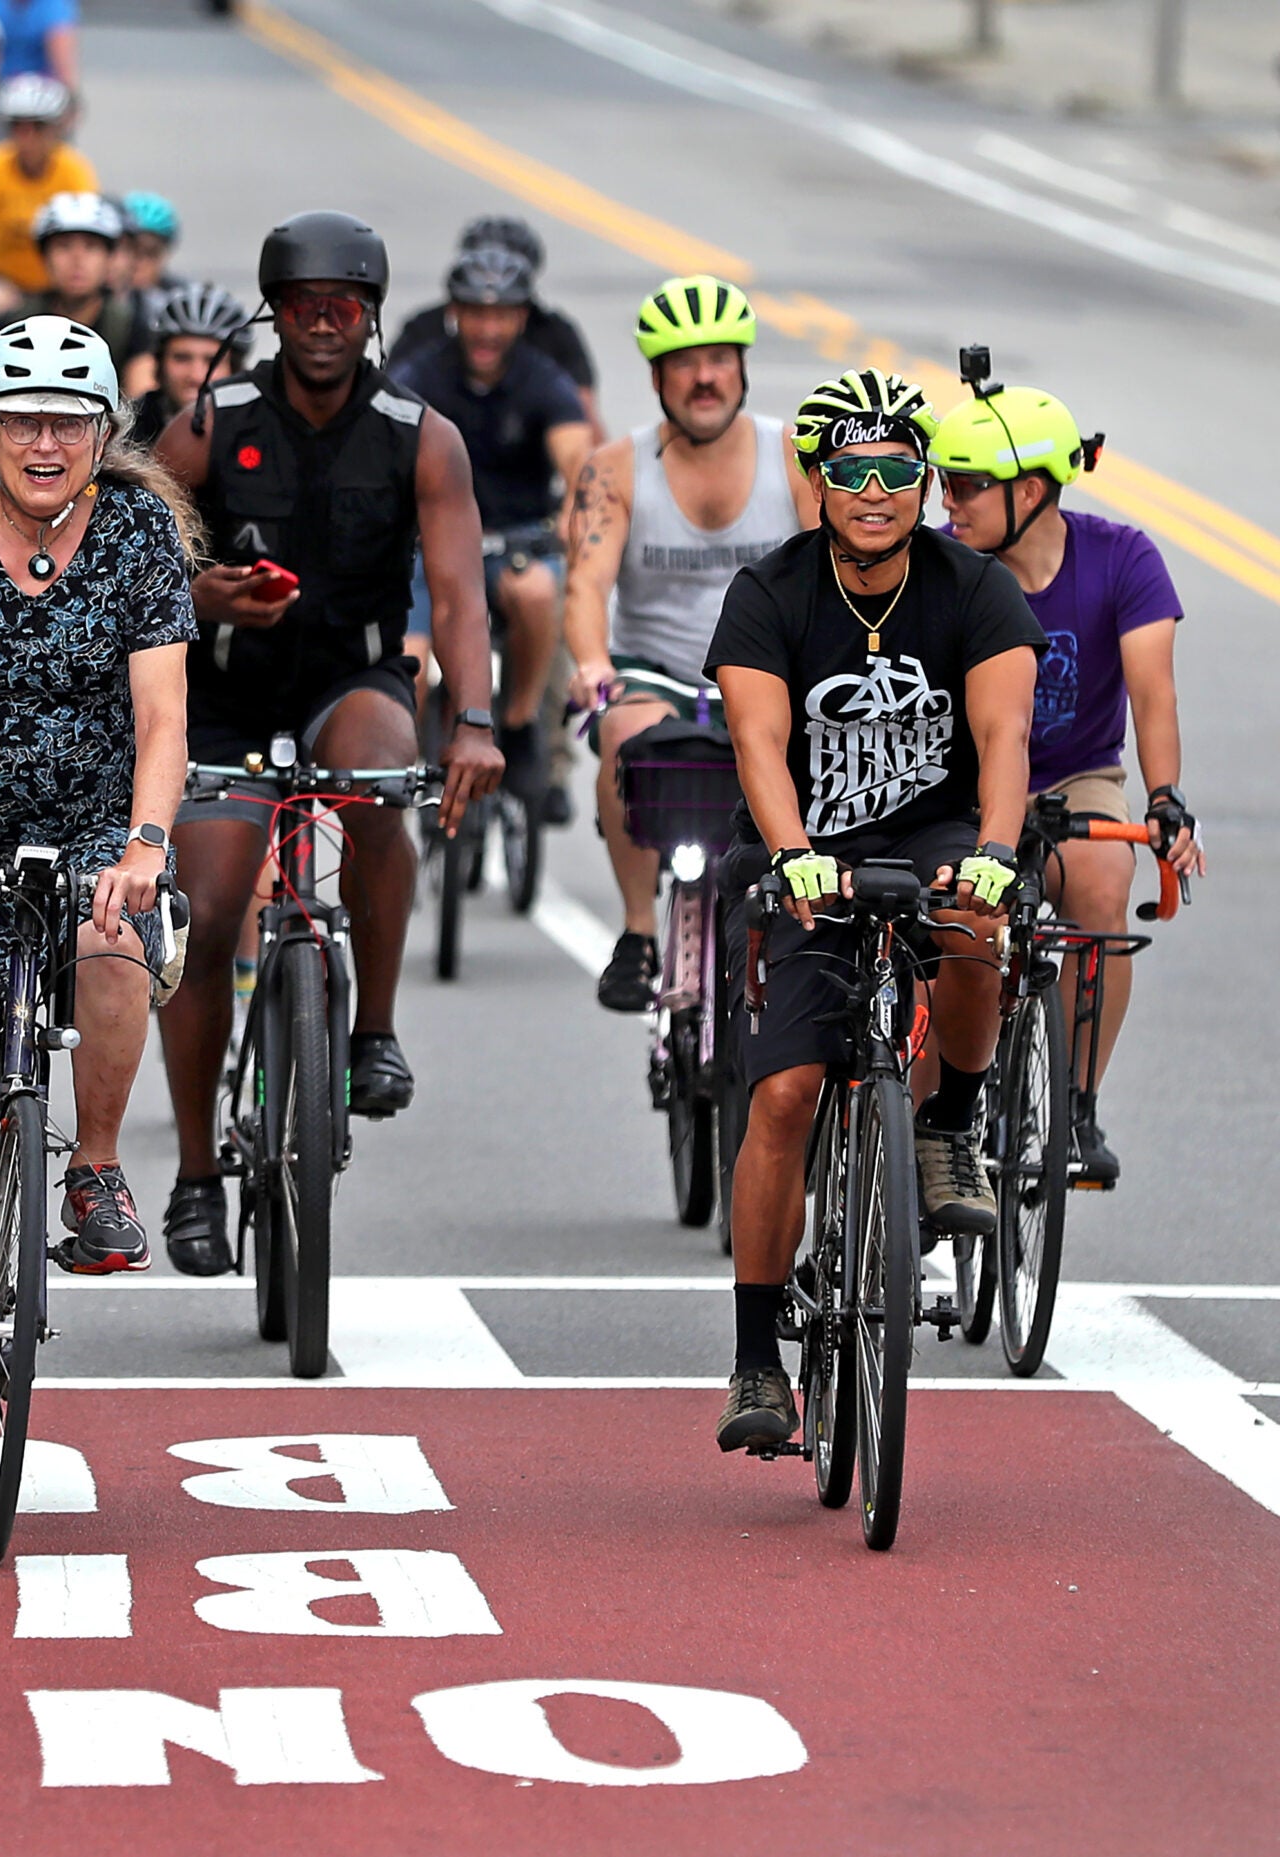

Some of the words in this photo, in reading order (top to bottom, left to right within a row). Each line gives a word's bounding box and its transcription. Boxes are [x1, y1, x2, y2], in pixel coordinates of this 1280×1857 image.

[831, 412, 894, 448] Clinch
[804, 715, 954, 803] BLACK
[804, 764, 949, 837] LIVES
